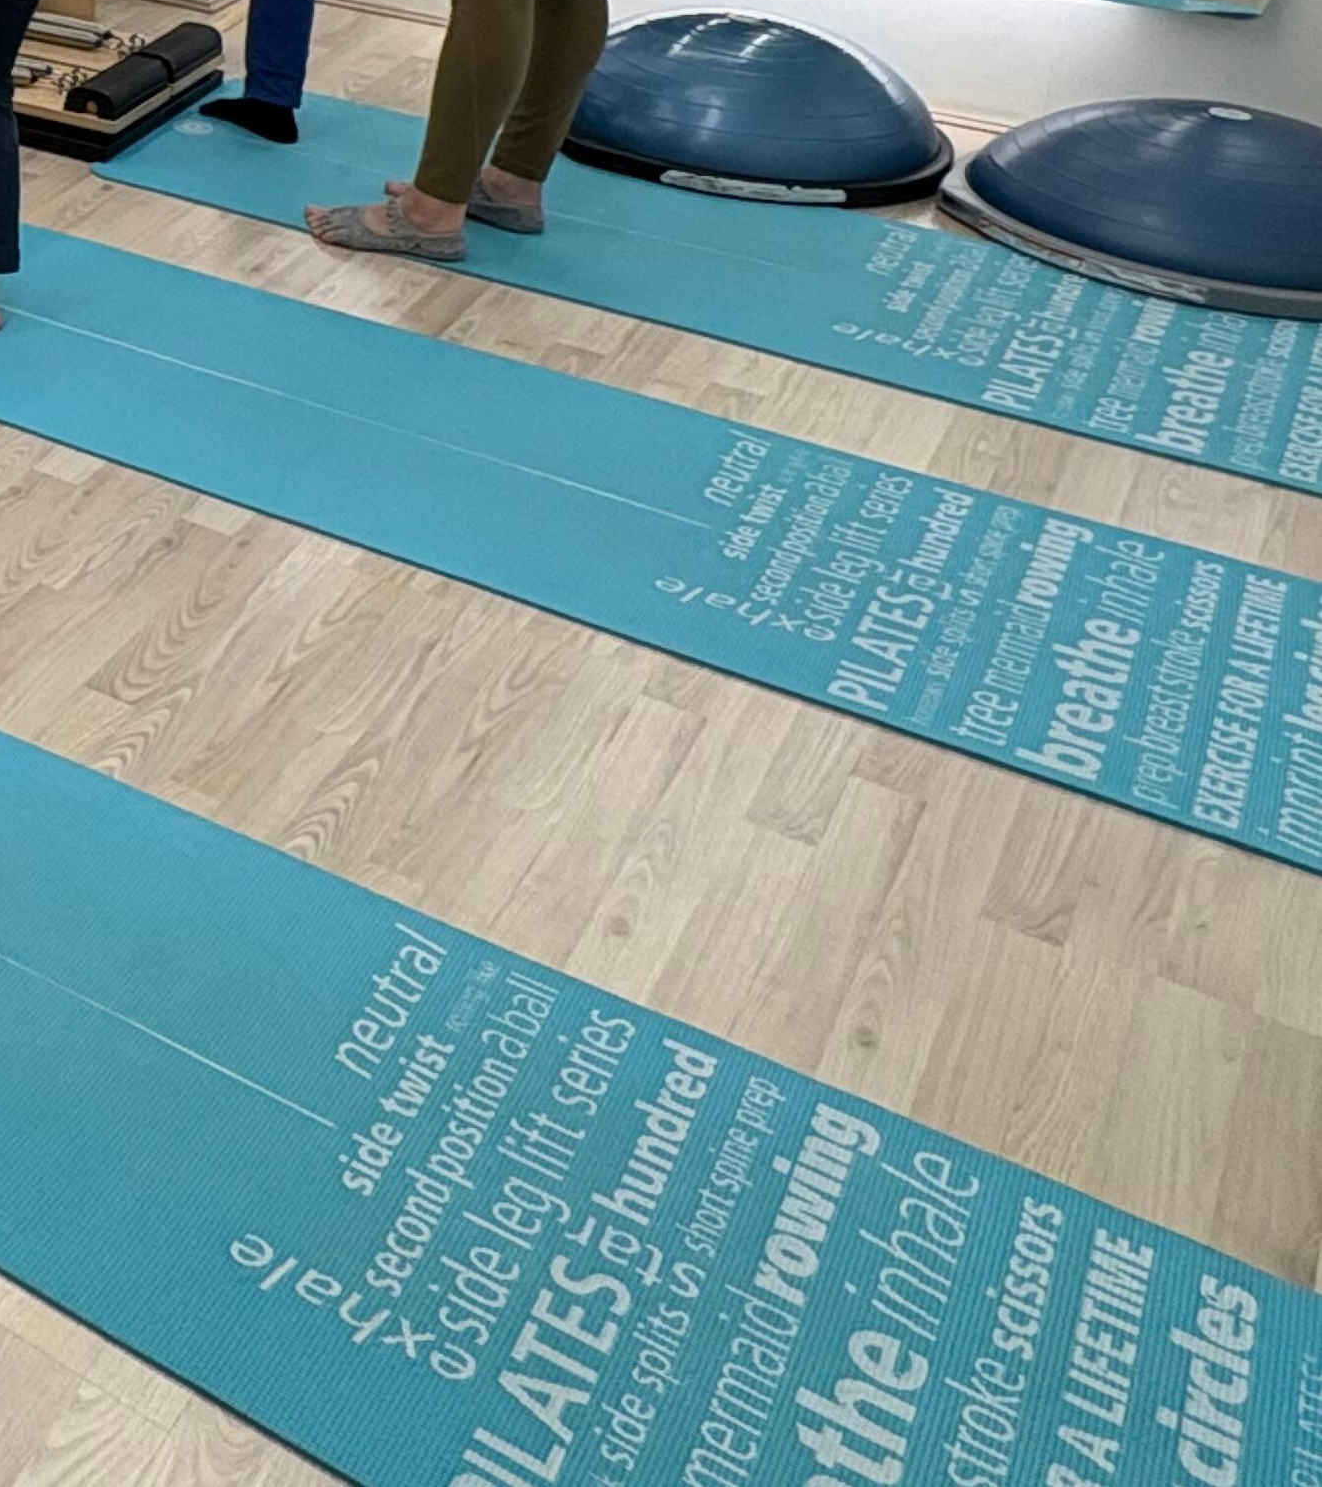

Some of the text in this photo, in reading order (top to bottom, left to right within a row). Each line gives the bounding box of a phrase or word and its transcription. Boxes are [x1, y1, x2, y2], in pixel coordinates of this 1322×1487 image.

[981, 329, 1064, 411] PILATES
[1135, 351, 1235, 455] breathe
[704, 430, 771, 506] neutral
[719, 484, 787, 560] side twist
[898, 487, 973, 573] hundred
[655, 576, 837, 641] exhale
[751, 547, 802, 605] second
[795, 473, 913, 626] side leg lift series
[1179, 560, 1224, 632] scissors
[827, 586, 935, 711] PILATES
[949, 518, 1094, 746] tree mermaid rowing
[1016, 540, 1165, 780] breathe inhale
[1151, 629, 1206, 690] stroke
[1193, 575, 1287, 829] EXERCISE FOR A LIFETIME
[1123, 685, 1193, 755] breast
[334, 921, 448, 1080] neutral
[486, 970, 559, 1036] ball
[337, 1032, 456, 1198] side twist
[365, 1057, 520, 1298] second position
[427, 1009, 636, 1347] side leg lift series
[590, 1038, 719, 1227] hundred
[675, 1074, 787, 1258] short spine prep
[564, 1215, 707, 1299] star
[753, 1101, 882, 1309] rowing
[844, 1150, 980, 1342] inhale
[985, 1195, 1063, 1362] scissors
[229, 1232, 477, 1381] exhale
[447, 1254, 632, 1487] ILATES
[1061, 1227, 1155, 1428] LIFETIME
[1157, 1273, 1259, 1487] circles
[593, 1393, 657, 1471] side
[631, 1303, 691, 1394] splits
